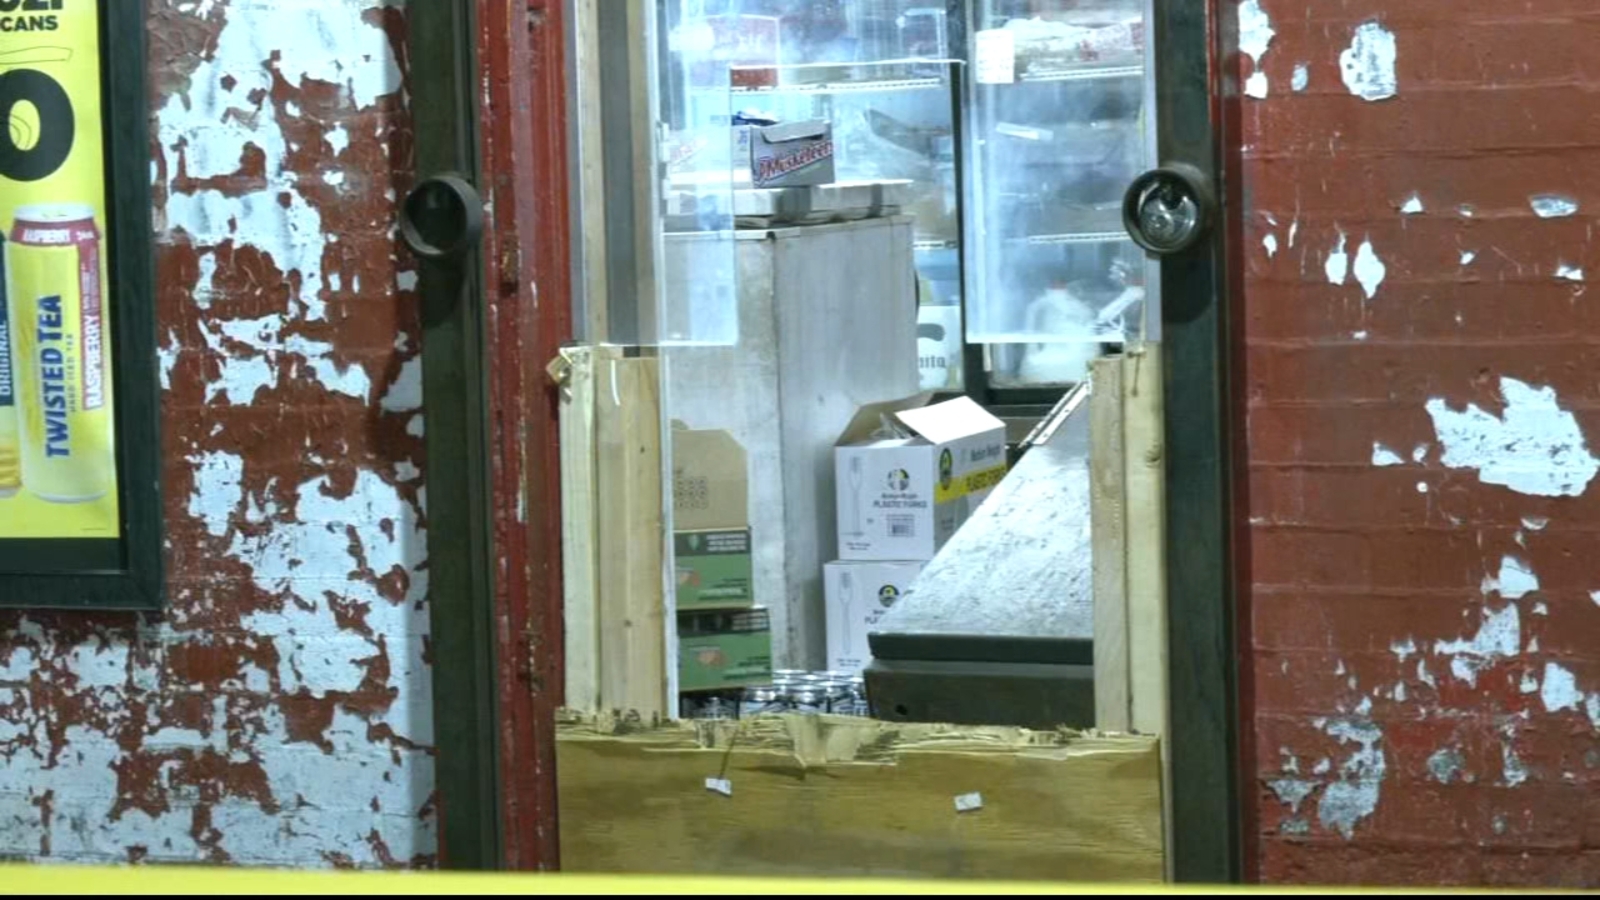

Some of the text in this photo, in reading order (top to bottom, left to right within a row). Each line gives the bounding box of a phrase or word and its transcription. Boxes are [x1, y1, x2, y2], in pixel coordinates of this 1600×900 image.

[0, 15, 58, 32] CANS
[37, 294, 69, 457] TWISTED TEA
[82, 315, 102, 409] RASPBERRY
